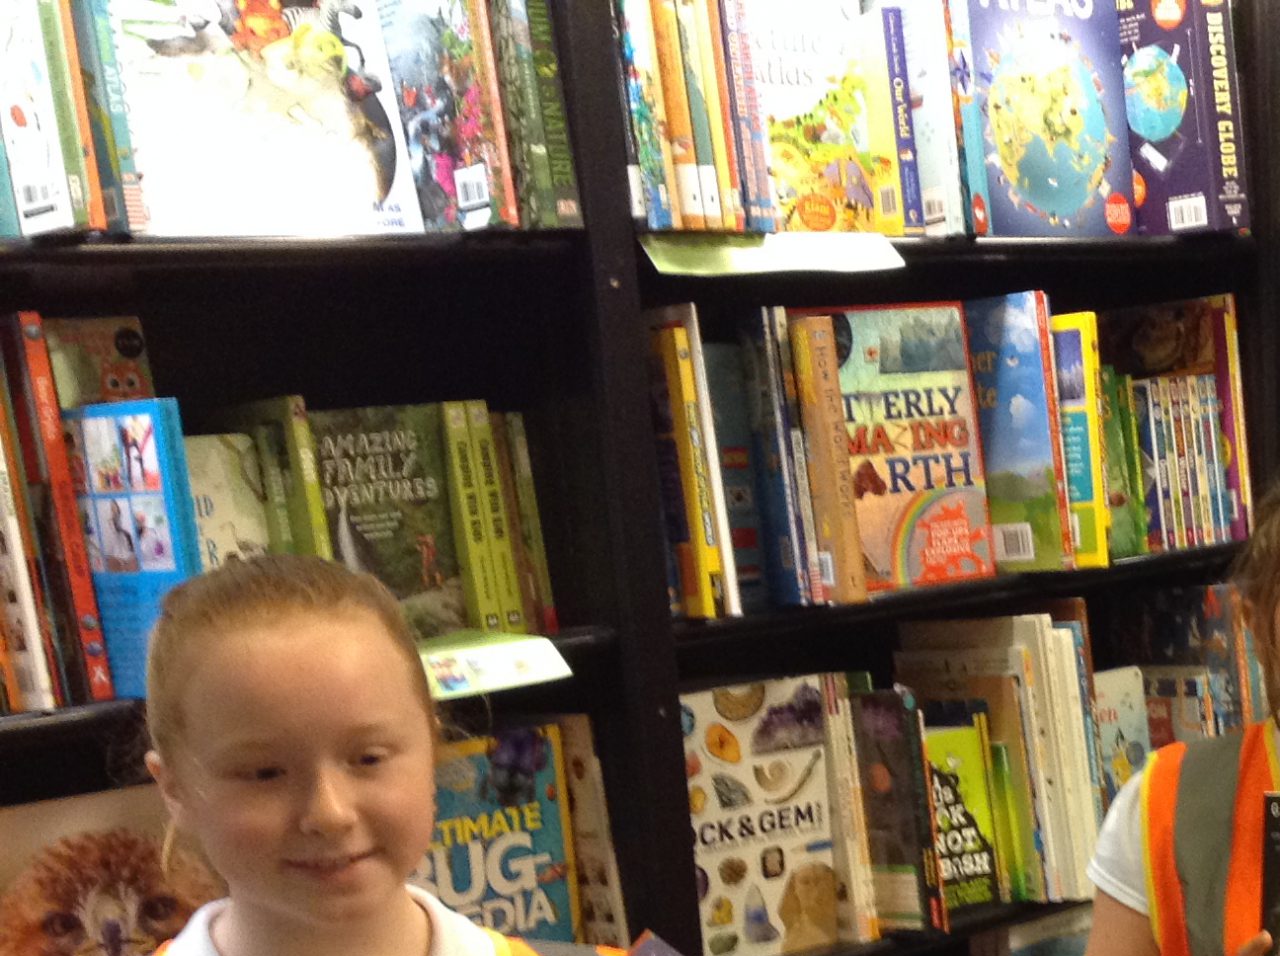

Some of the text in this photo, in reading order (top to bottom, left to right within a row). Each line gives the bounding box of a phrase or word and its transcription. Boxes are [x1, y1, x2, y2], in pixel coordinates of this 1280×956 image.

[1206, 12, 1239, 178] DISCOVERY GLOBE
[541, 99, 574, 187] NATURE
[814, 344, 829, 381] How
[321, 430, 417, 457] AMAZING
[847, 418, 970, 455] MAZING
[322, 452, 417, 487] FAMILY
[322, 477, 439, 509] DVENTURES
[430, 800, 543, 850] TIMATE
[699, 804, 815, 847] CK & GEM
[461, 886, 558, 934] EDIA
